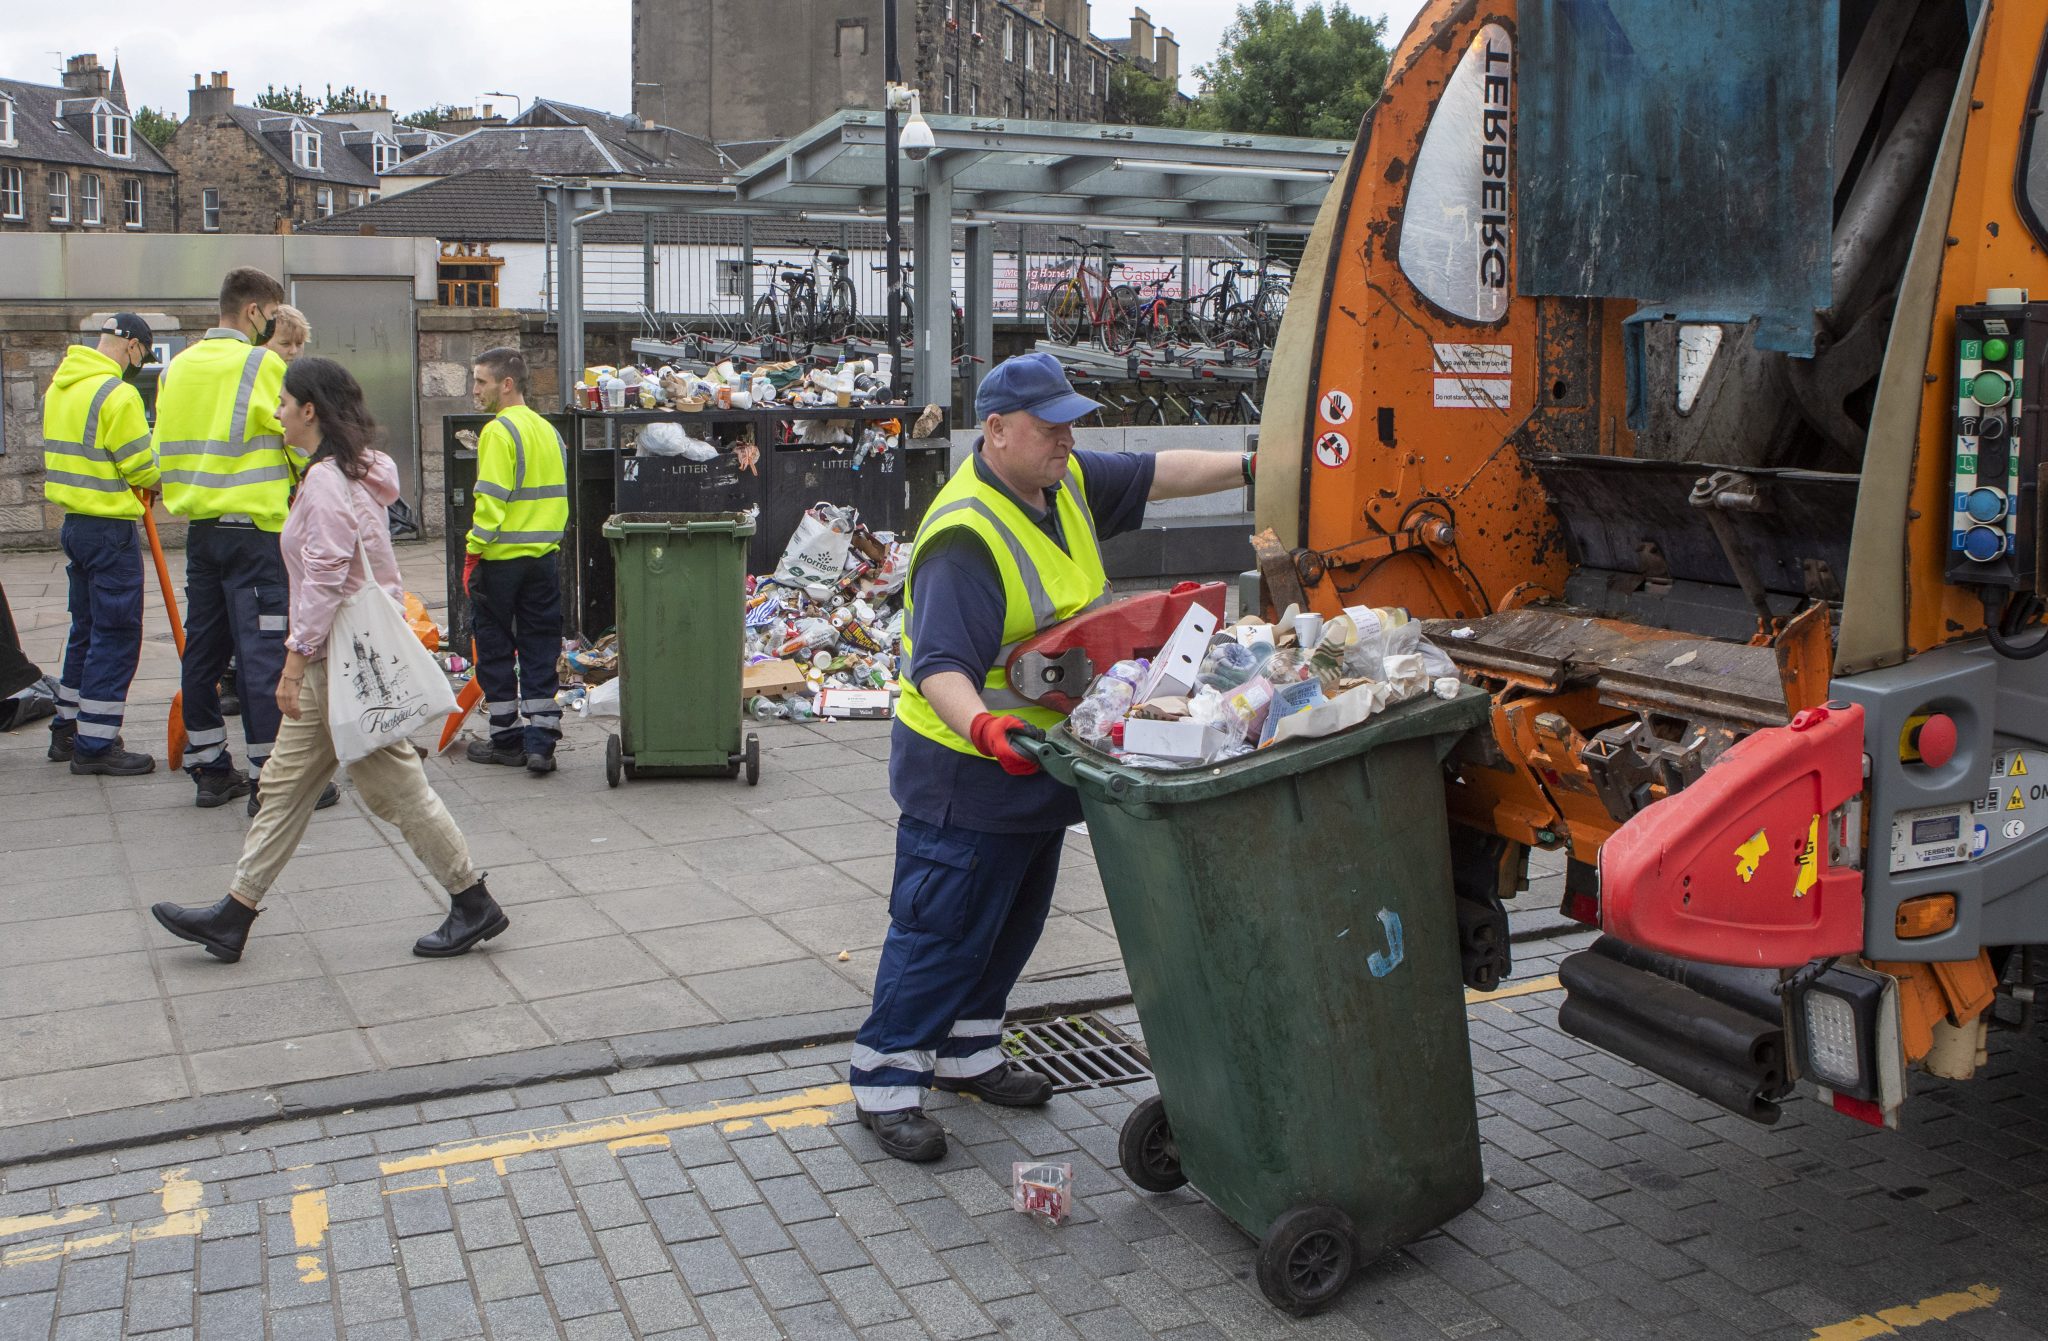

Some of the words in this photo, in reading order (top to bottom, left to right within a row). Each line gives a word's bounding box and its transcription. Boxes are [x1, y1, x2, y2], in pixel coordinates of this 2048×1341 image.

[1481, 38, 1509, 290] TERBERG
[1004, 268, 1038, 279] Mong
[1122, 266, 1169, 281] Castle
[672, 464, 708, 474] LITTER
[822, 460, 853, 469] LITTE
[798, 553, 839, 572] Morrisons
[1923, 845, 1956, 856] TERBERG
